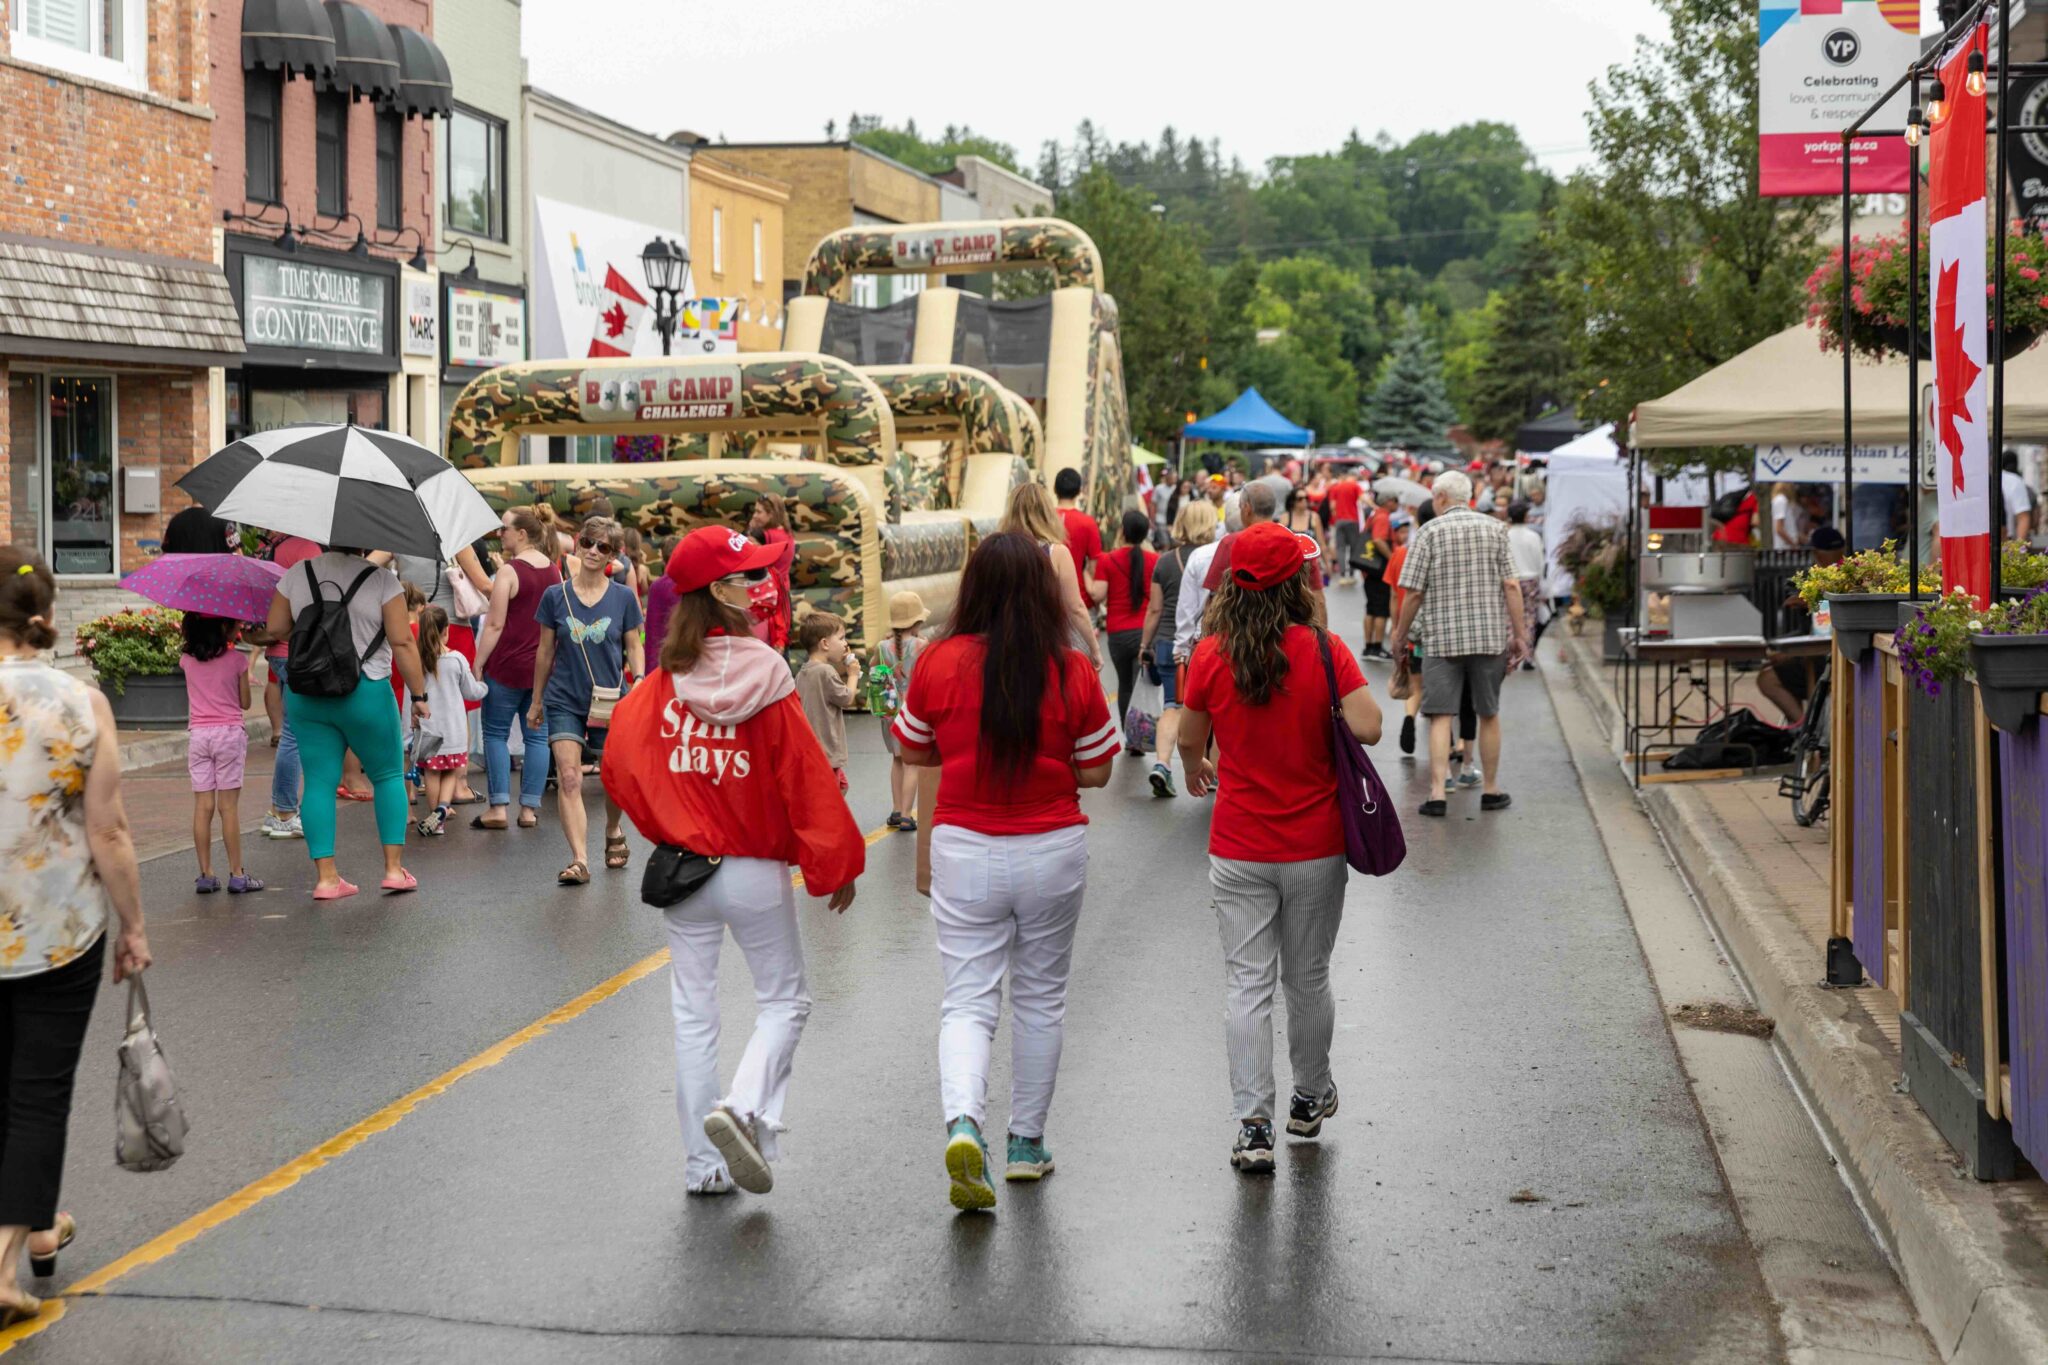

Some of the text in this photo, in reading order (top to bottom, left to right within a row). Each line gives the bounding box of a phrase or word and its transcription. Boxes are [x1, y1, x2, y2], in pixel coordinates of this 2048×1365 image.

[1828, 40, 1855, 57] YP
[1803, 76, 1879, 87] Celebrating
[1790, 91, 1885, 104] love, communit
[1810, 109, 1819, 119] &
[952, 234, 996, 252] CAMP
[934, 251, 993, 265] CHALLENGE
[278, 266, 360, 305] TIME SQUARE
[252, 306, 378, 348] CONVENIENCE
[409, 315, 434, 340] MARC
[668, 376, 733, 402] CAMP
[642, 404, 727, 420] CHALLENGE
[1801, 442, 1887, 459] Corinhian
[669, 732, 750, 786] days
